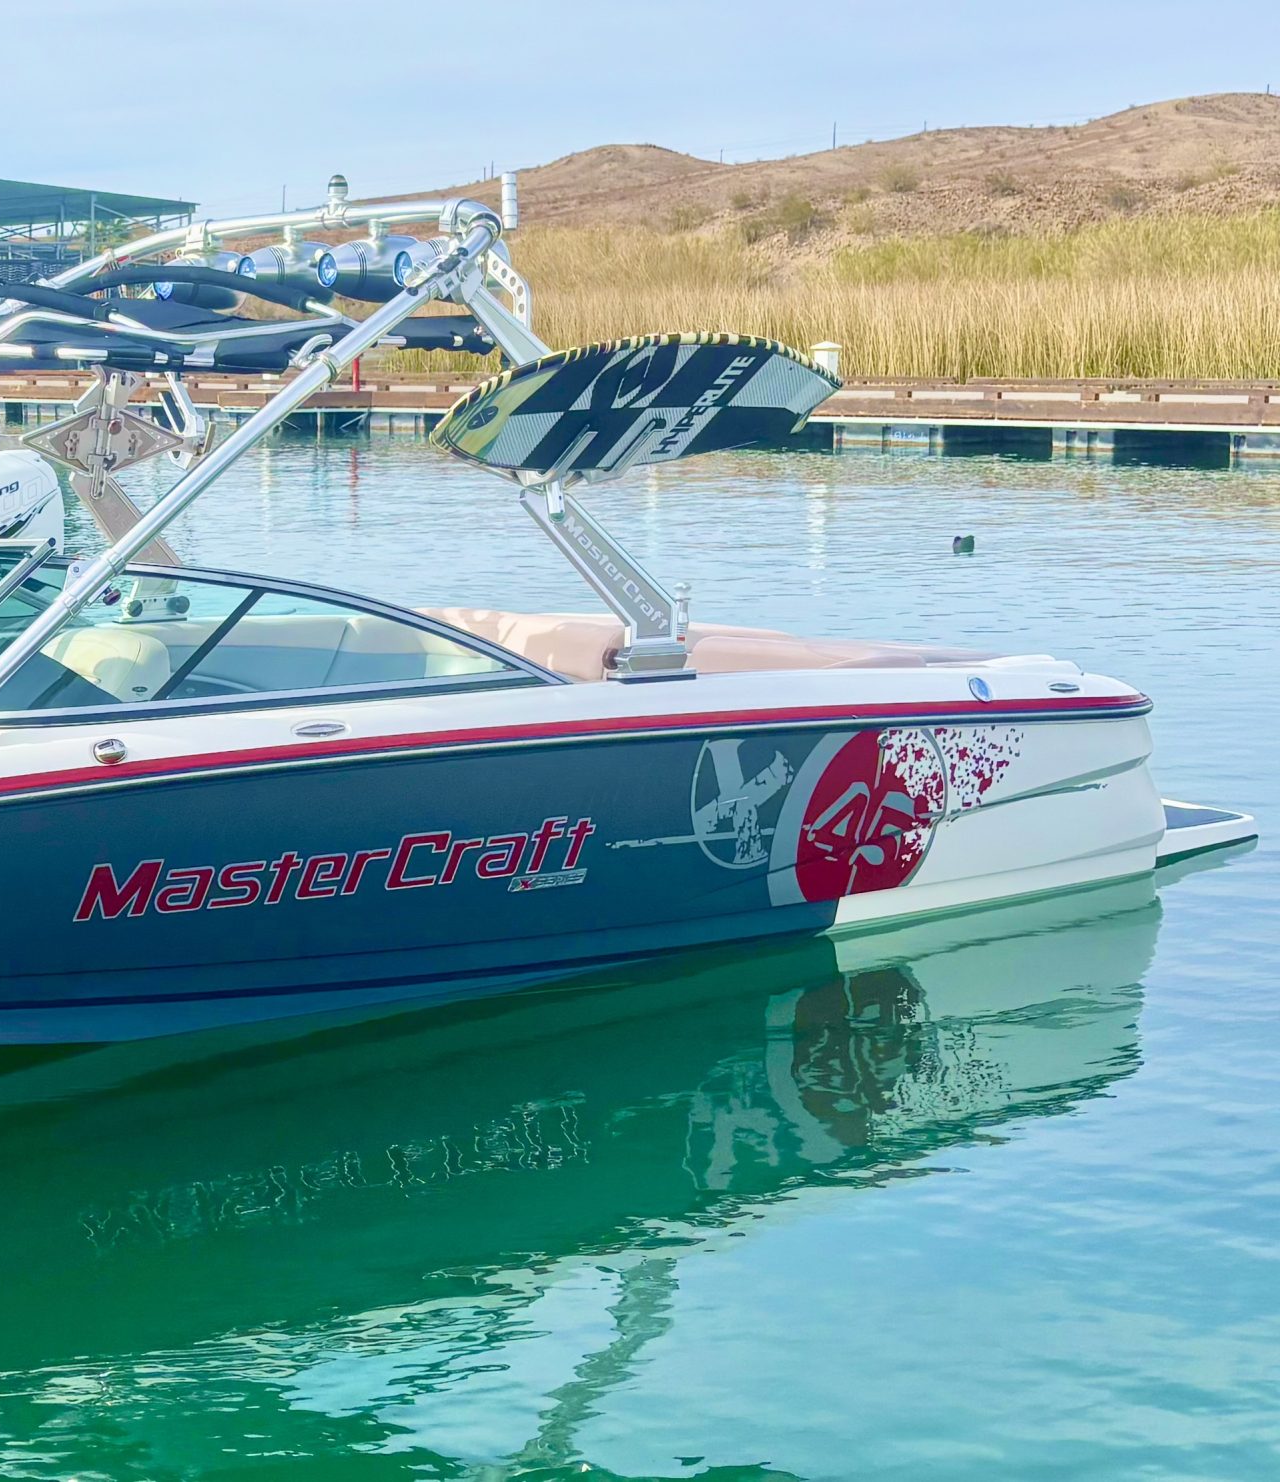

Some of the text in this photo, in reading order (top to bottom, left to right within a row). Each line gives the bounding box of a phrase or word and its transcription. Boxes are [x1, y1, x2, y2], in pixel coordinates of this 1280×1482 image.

[650, 356, 756, 455] HYPERLITE
[562, 516, 670, 630] MasterCraft
[72, 815, 597, 922] MasterCraft
